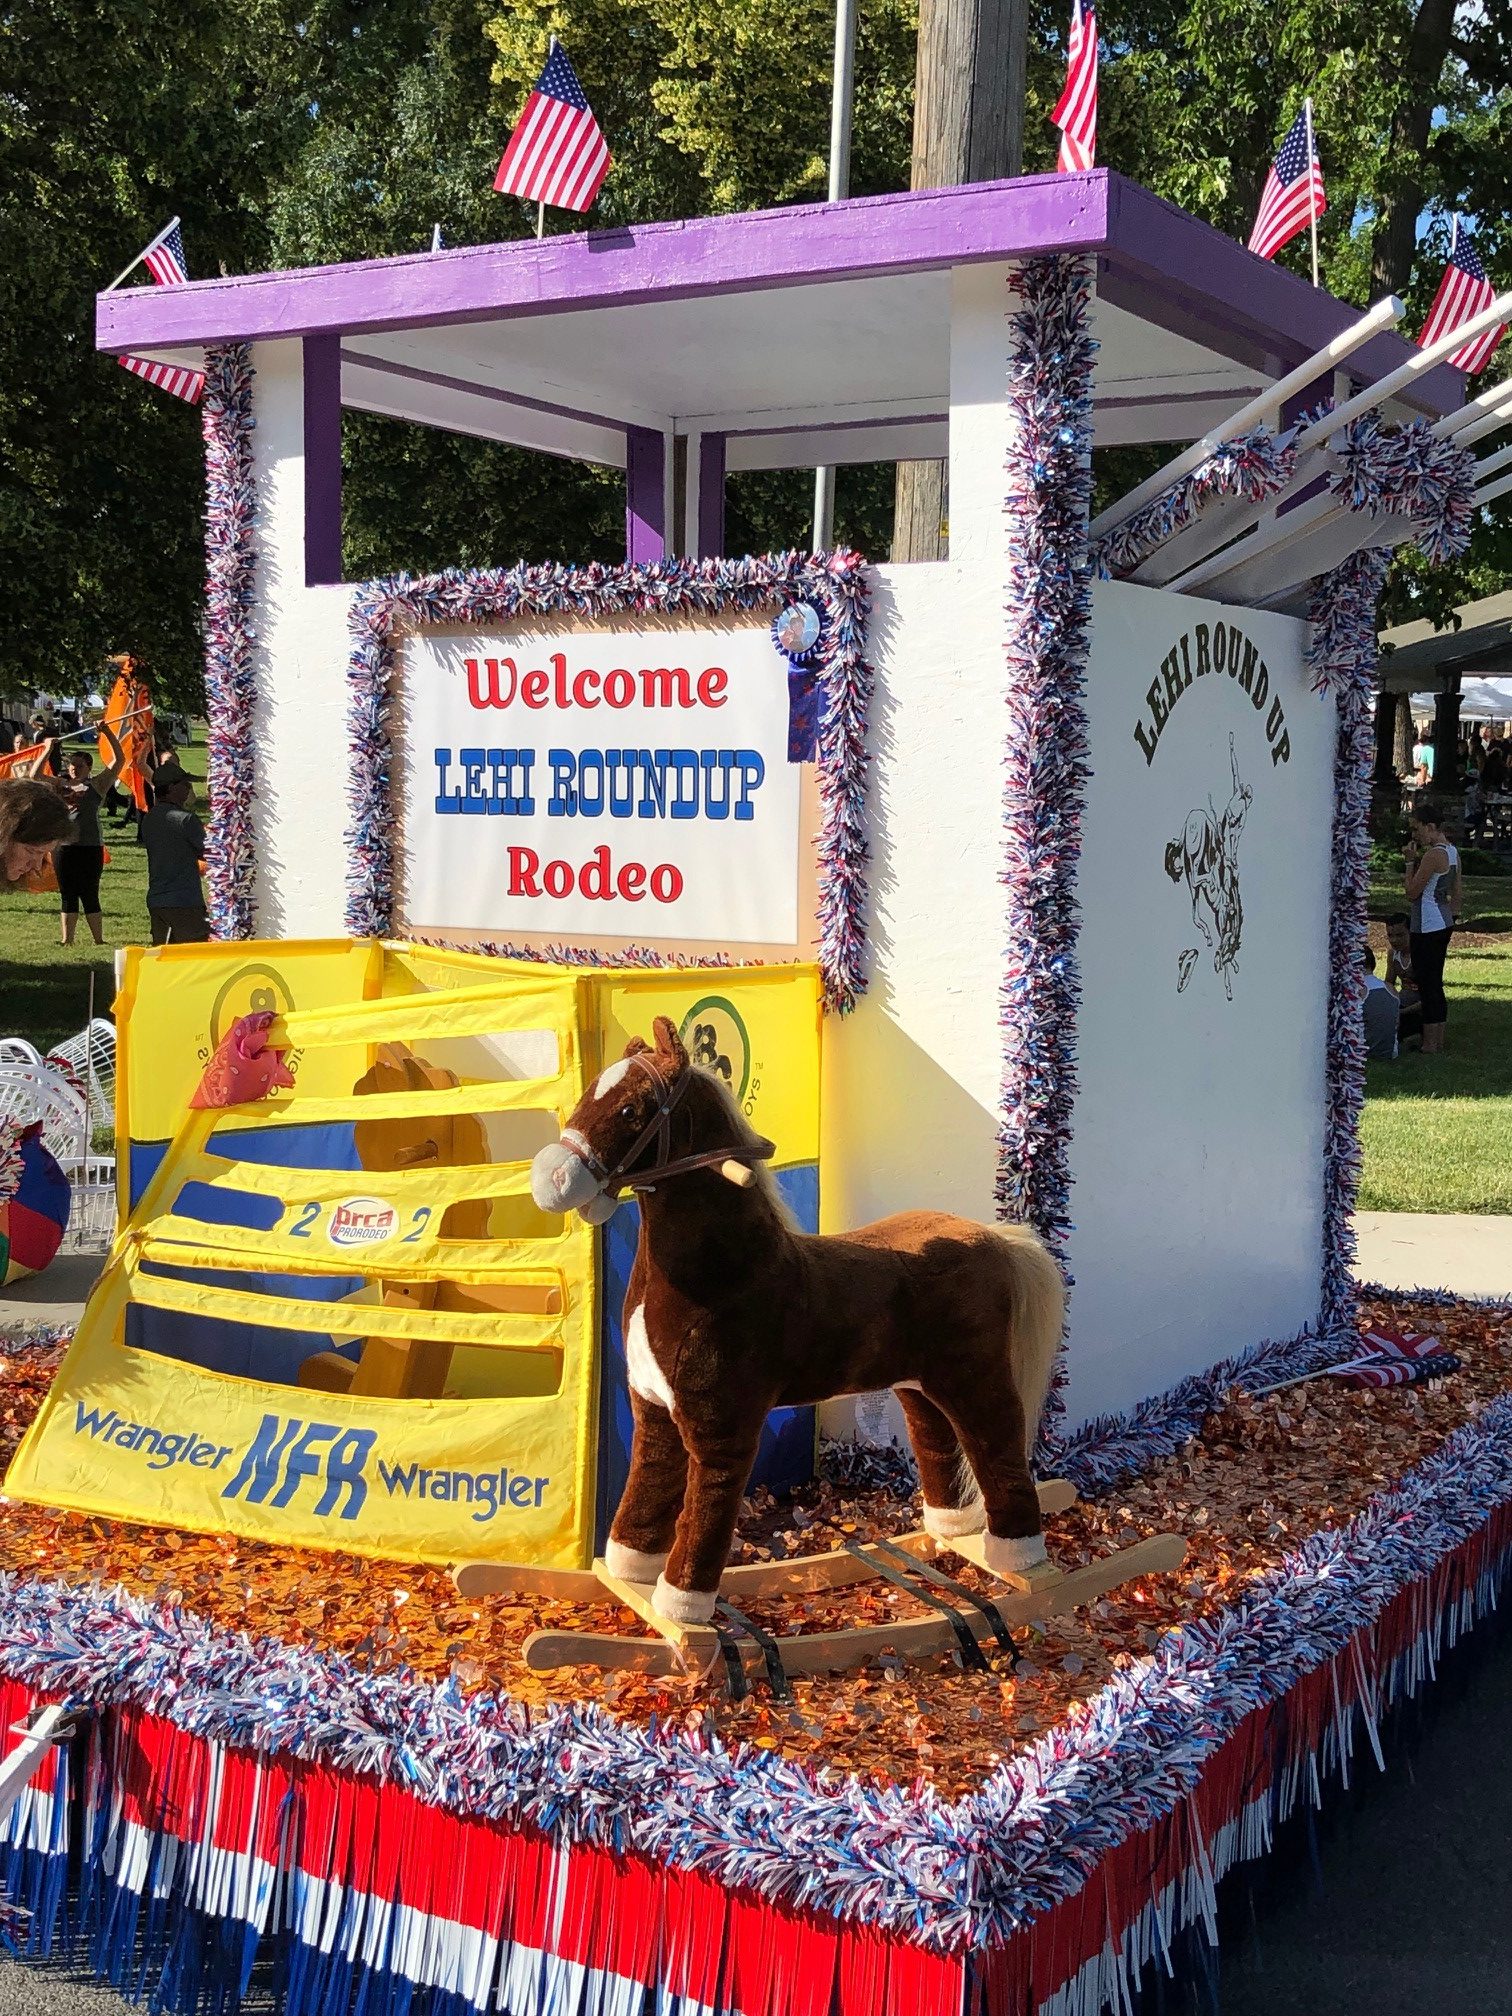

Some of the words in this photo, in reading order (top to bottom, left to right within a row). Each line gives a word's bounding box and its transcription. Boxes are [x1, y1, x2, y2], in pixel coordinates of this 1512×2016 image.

[464, 653, 728, 710] Welcome
[1134, 633, 1193, 767] LEHI
[435, 748, 535, 816] LEHI
[548, 749, 765, 821] ROUNDUP
[507, 845, 684, 903] Rodeo
[288, 1201, 322, 1238] 2
[332, 1205, 394, 1235] prca
[338, 1227, 388, 1239] PRORODEO
[400, 1207, 432, 1243] 2
[75, 1400, 234, 1470] Wrangler
[221, 1414, 380, 1521] NFR
[378, 1459, 550, 1522] Wrangler
